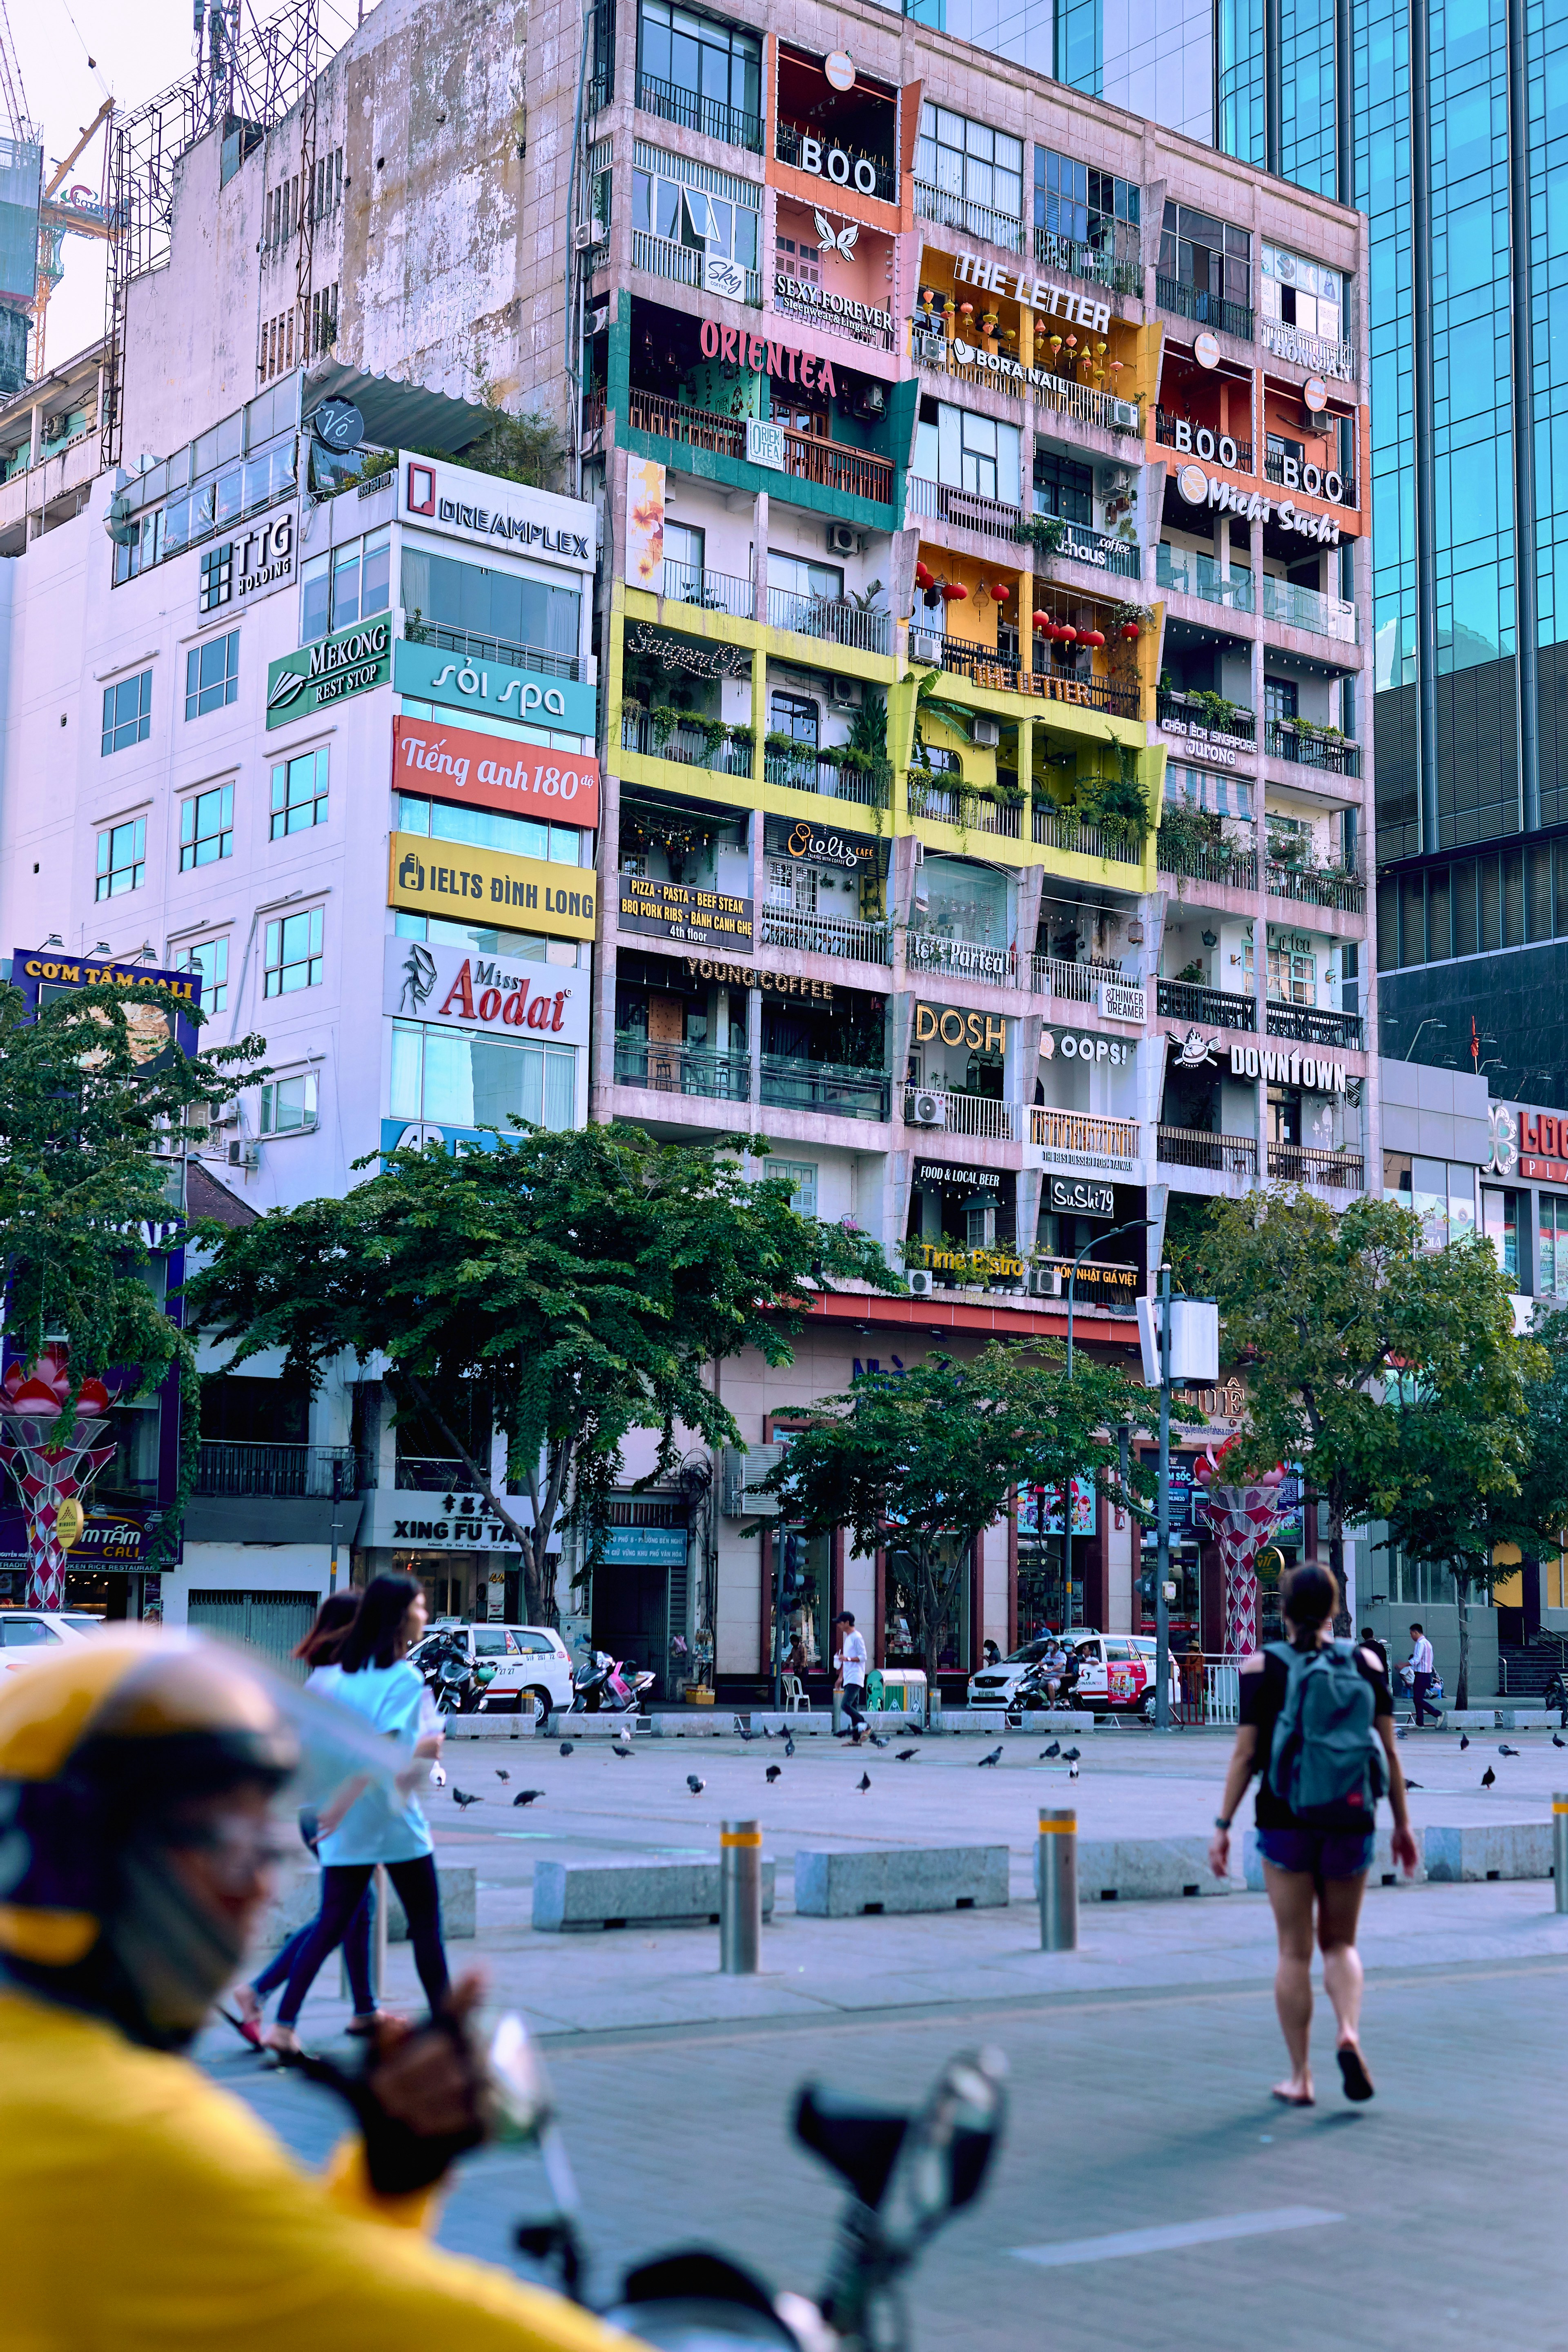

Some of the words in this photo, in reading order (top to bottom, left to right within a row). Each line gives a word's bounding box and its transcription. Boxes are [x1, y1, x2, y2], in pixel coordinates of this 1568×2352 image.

[802, 136, 875, 195] BOO
[708, 261, 742, 294] Sky
[710, 281, 727, 291] COFFEE
[958, 249, 1009, 296] THE
[1014, 272, 1110, 334] LETTER
[777, 275, 818, 305] SEXY
[821, 290, 894, 332] FOREVER
[699, 319, 837, 398] ORIENTEA
[975, 350, 1023, 380] BORA
[1028, 368, 1066, 395] NAIL
[1175, 419, 1237, 469] BOO
[1282, 454, 1343, 502] BOO
[440, 497, 589, 559] DREAMPLEX
[1208, 477, 1270, 523] Michi
[1277, 499, 1340, 545] Sushi
[234, 514, 291, 577] TTG
[1100, 538, 1130, 555] coffee
[238, 557, 291, 596] HOLDING
[307, 624, 386, 679] MEKONG
[315, 677, 344, 703] REST
[347, 664, 376, 690] STOP
[972, 662, 1013, 692] THE
[1017, 670, 1091, 706] LETTER
[1210, 730, 1258, 753] SINGAPORE
[401, 739, 470, 787] Tiếng
[477, 760, 528, 791] anh
[533, 765, 579, 800] 180
[855, 846, 874, 857] CAFÉ
[430, 865, 483, 899] IELTS
[490, 875, 538, 909] ĐÌNH
[546, 887, 593, 919] LONG
[631, 880, 655, 898] PIZZA
[663, 886, 689, 904] PASTA
[697, 892, 717, 909] BEEF
[719, 897, 744, 914] STEAK
[622, 898, 638, 916] BBQ
[640, 902, 662, 919] PORK
[664, 906, 683, 923] RIBS
[691, 909, 712, 928] BÁNH
[714, 916, 735, 933] CANH
[737, 920, 752, 938] GHẸ
[670, 925, 684, 938] 4th
[687, 927, 707, 942] floor
[24, 960, 80, 982] CƠM
[474, 960, 520, 990] Miss
[686, 956, 755, 987] YOUNG
[760, 970, 834, 1000] COFFEE
[439, 959, 565, 1031] Aodai
[1108, 1001, 1144, 1019] DREAMER
[1111, 988, 1143, 1006] THINKER
[916, 1004, 1006, 1054] DOSH
[1061, 1035, 1127, 1066] OOPS!
[921, 1166, 943, 1180] FOOD
[944, 1169, 951, 1180] &
[952, 1170, 978, 1184] LOCAL
[980, 1174, 1000, 1187] BEER
[1042, 1151, 1054, 1162] THE
[1055, 1152, 1069, 1163] BEST
[1069, 1154, 1094, 1166] DESSERT
[1095, 1158, 1110, 1169] FORM
[1111, 1159, 1134, 1172] TAIWAN
[1077, 1268, 1100, 1283] NHẬT
[1103, 1269, 1117, 1284] GIÁ
[1118, 1272, 1137, 1287] VIỆT
[394, 1520, 449, 1540] XING
[455, 1523, 482, 1541] FU
[102, 1546, 139, 1558] CALI
